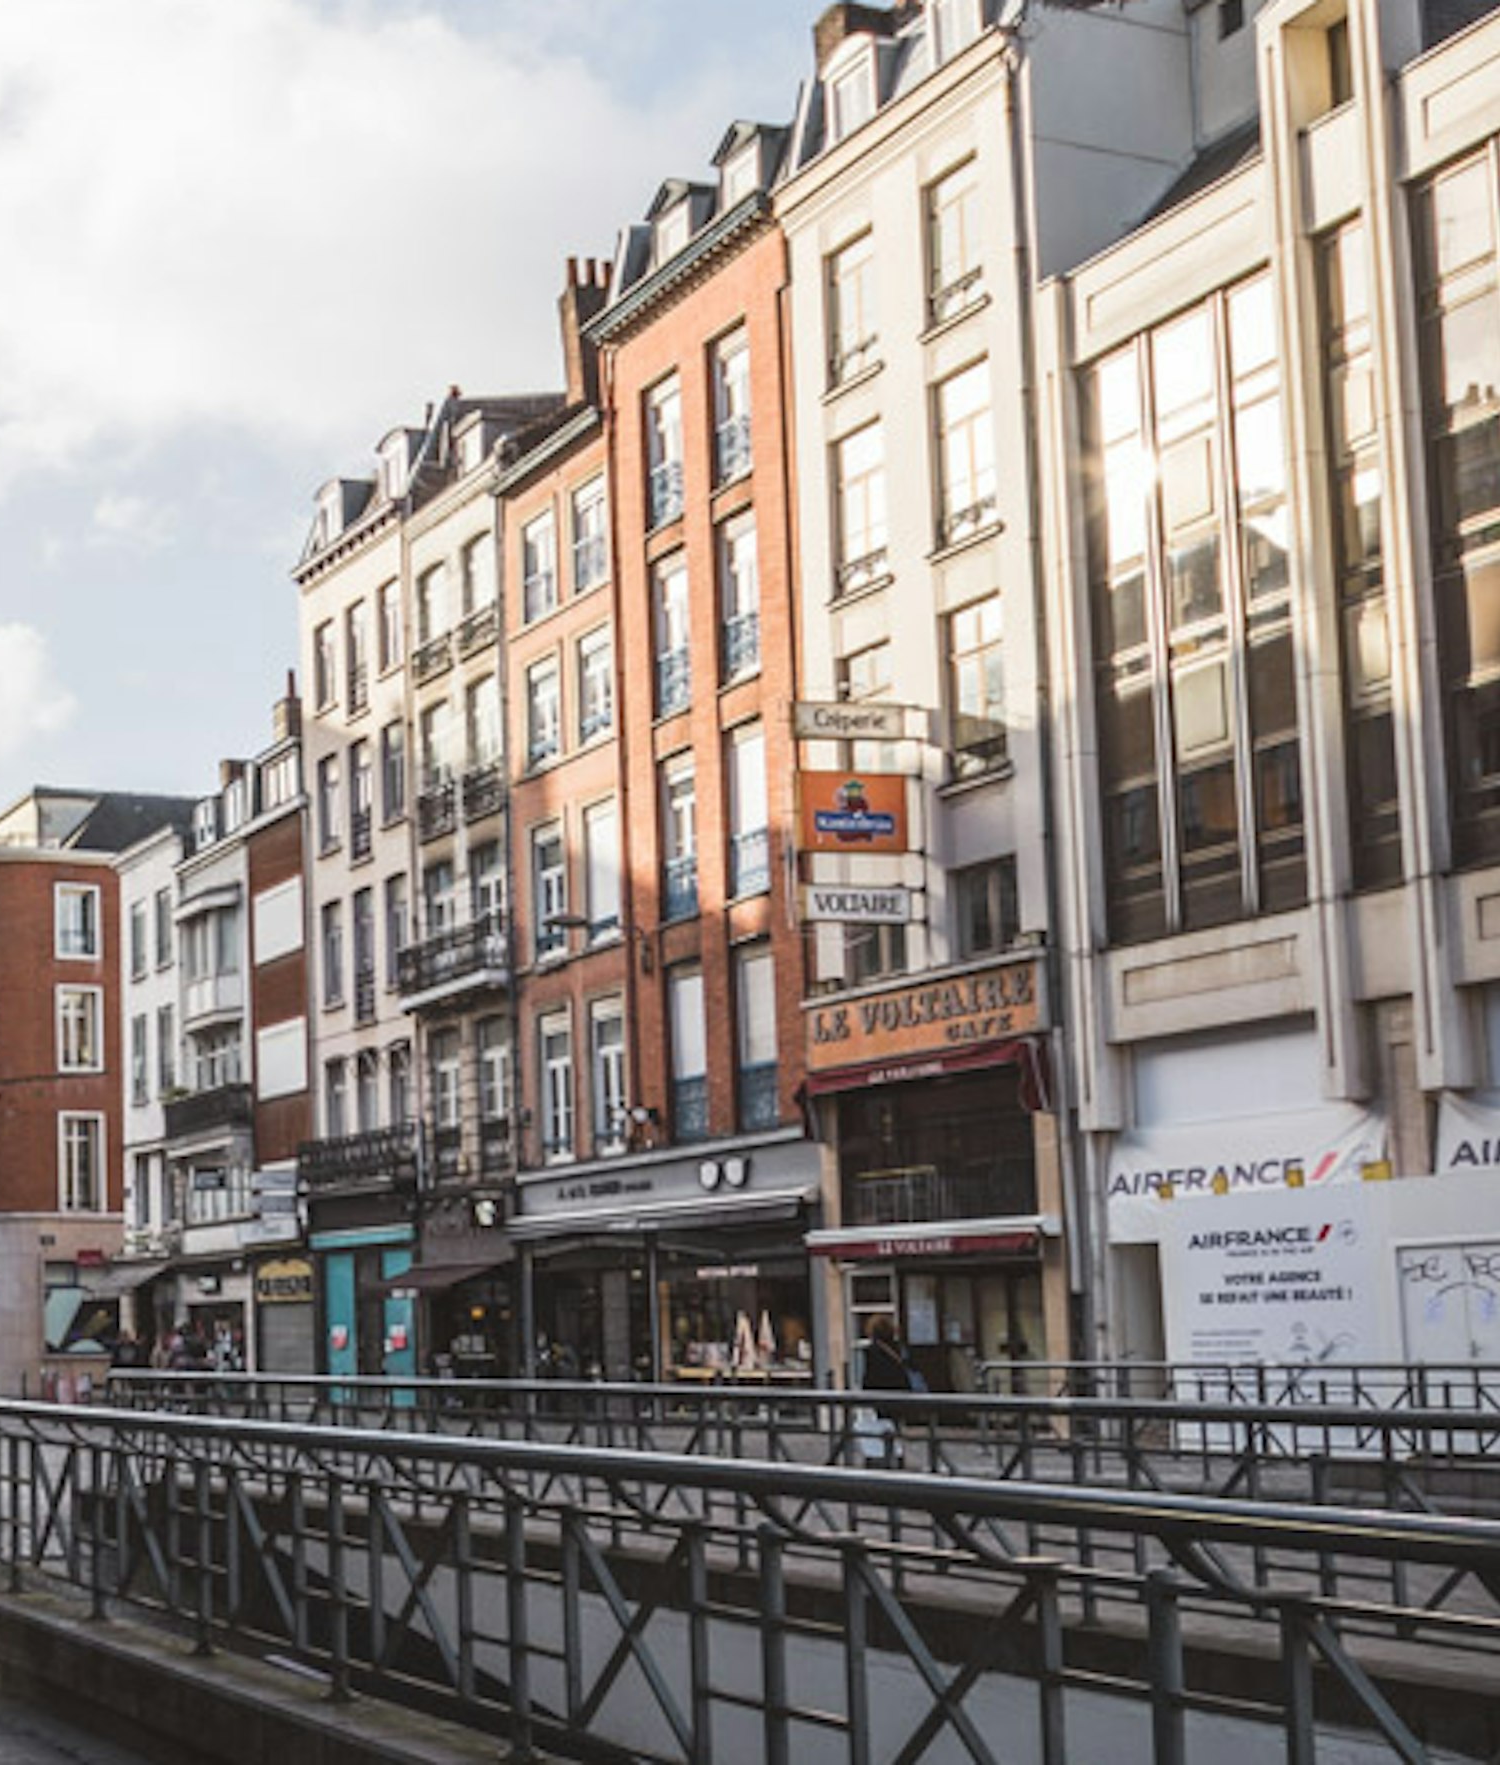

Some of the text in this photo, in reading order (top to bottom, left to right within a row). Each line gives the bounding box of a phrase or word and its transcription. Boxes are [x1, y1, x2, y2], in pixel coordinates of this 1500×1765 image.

[814, 893, 902, 915] VOLTAIRE
[815, 968, 1033, 1044] LE VOLTAIRE
[1450, 1140, 1500, 1168] AI
[1188, 1226, 1311, 1249] AIRFRANCE
[1223, 1270, 1322, 1286] VOTRE AGENCE
[1217, 1291, 1258, 1304] REFAIT
[1263, 1290, 1288, 1303] UNE
